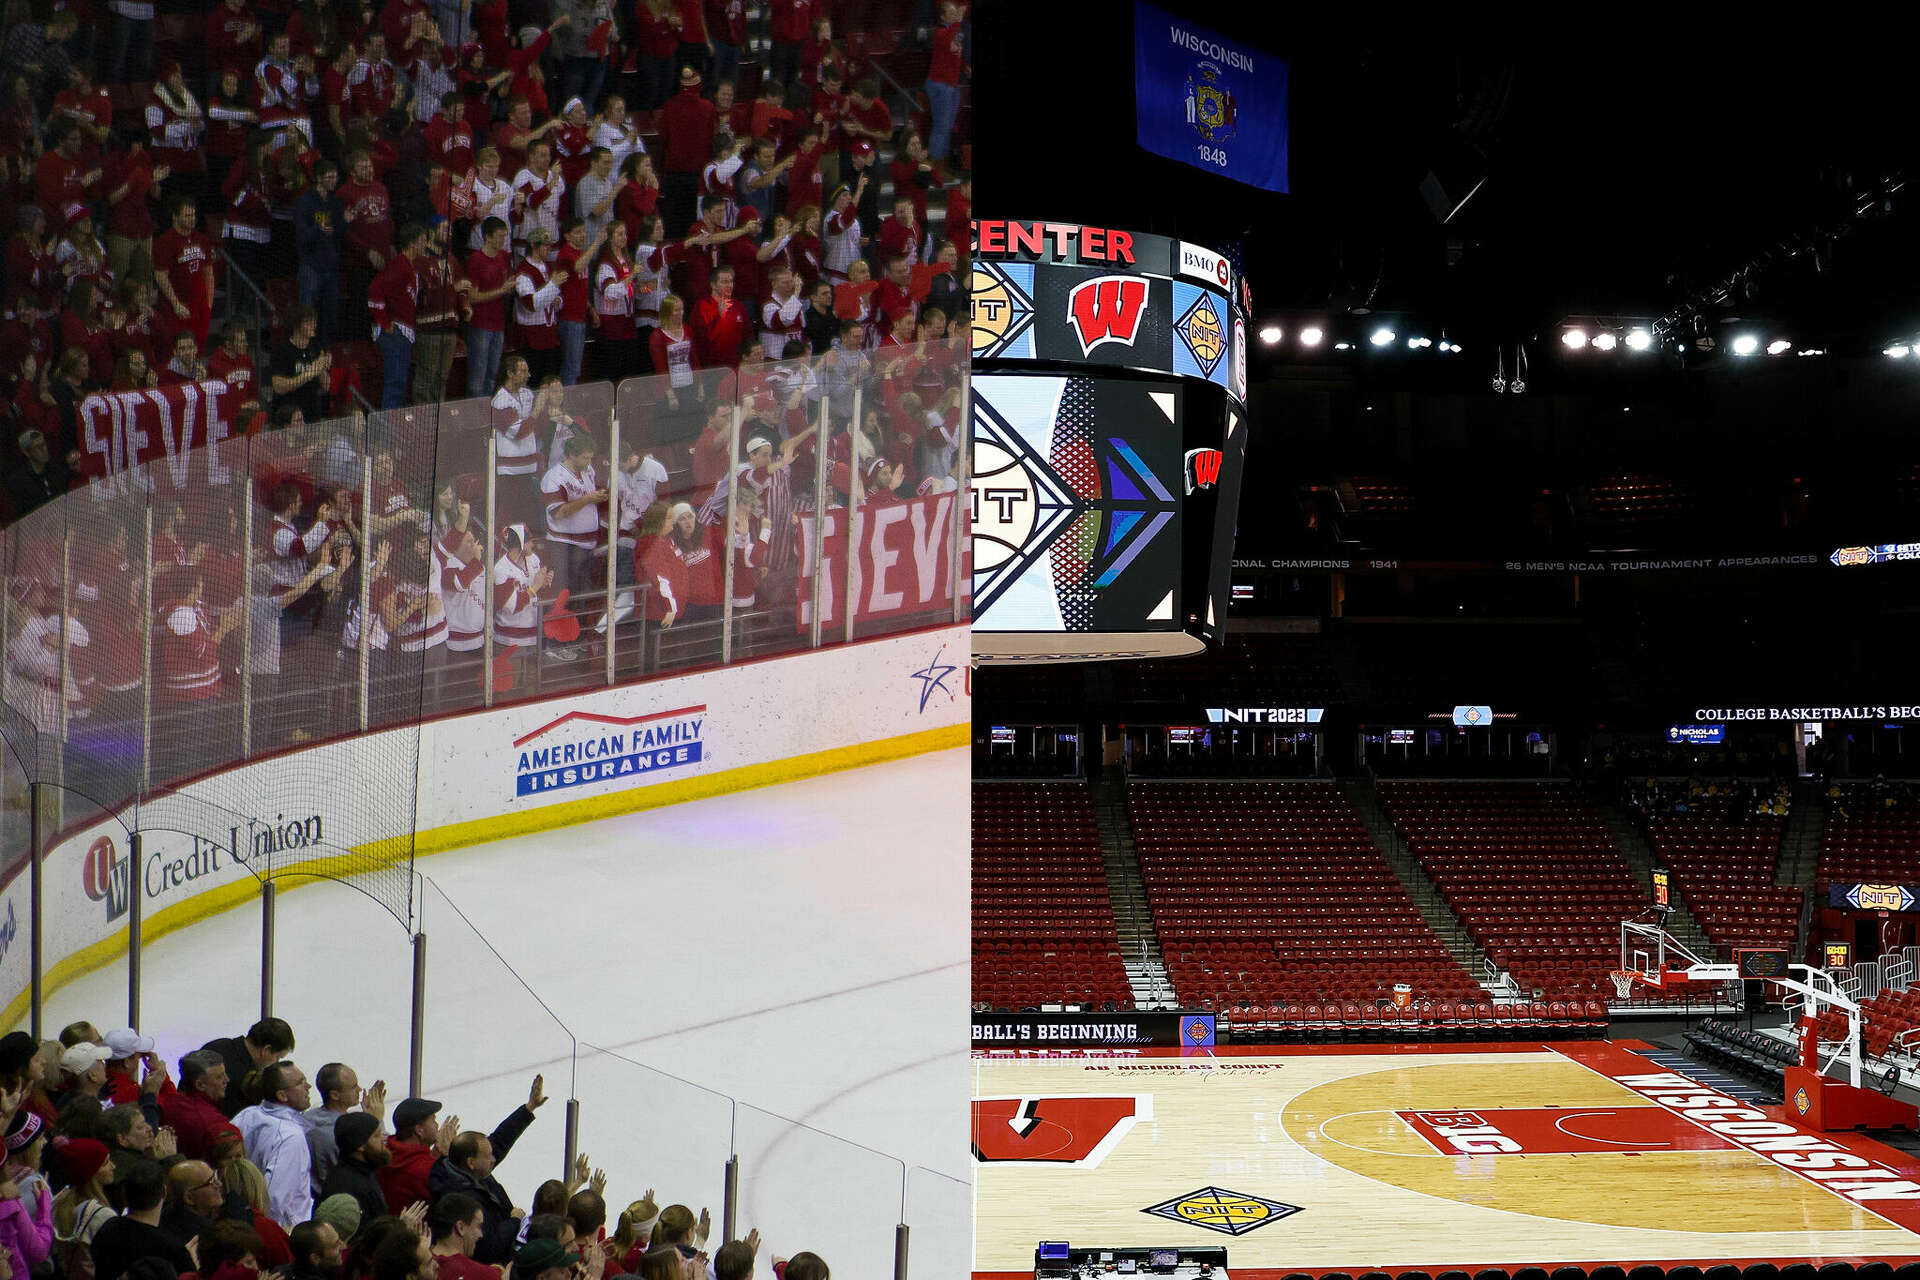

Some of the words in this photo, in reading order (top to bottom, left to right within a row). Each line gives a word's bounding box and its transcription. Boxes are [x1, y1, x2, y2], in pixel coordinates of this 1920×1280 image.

[1171, 26, 1254, 73] WISCONSIN
[1198, 144, 1227, 167] 1848
[971, 220, 1136, 264] ENTER
[1184, 251, 1214, 272] BMO
[1191, 323, 1220, 344] NIT
[80, 380, 232, 502] SIEVE
[1272, 560, 1350, 568] CHAMPIONS
[1369, 560, 1398, 569] 1941
[1505, 562, 1522, 570] 26
[1526, 562, 1565, 571] MEN'S
[1569, 562, 1605, 571] NCAA
[1611, 559, 1713, 570] TOURNAMENT
[1718, 555, 1818, 567] APPEARANCES
[1696, 708, 1766, 721] COLLEGE
[1769, 707, 1886, 720] BASKETBALL'S
[1680, 728, 1719, 736] NICHOLAS
[518, 734, 624, 773] AMERICAN
[633, 719, 702, 751] FAMILY
[531, 747, 689, 790] INSURANCE
[145, 835, 222, 898] Credit
[229, 813, 323, 864] Union
[1656, 885, 1668, 905] 30
[1862, 892, 1900, 904] NIT
[1830, 955, 1844, 966] 30
[971, 1024, 1031, 1040] BALL'S
[1037, 1024, 1137, 1040] BEGINNING
[1613, 1072, 1920, 1200] WISCONSIN
[1184, 1205, 1261, 1214] NIT
